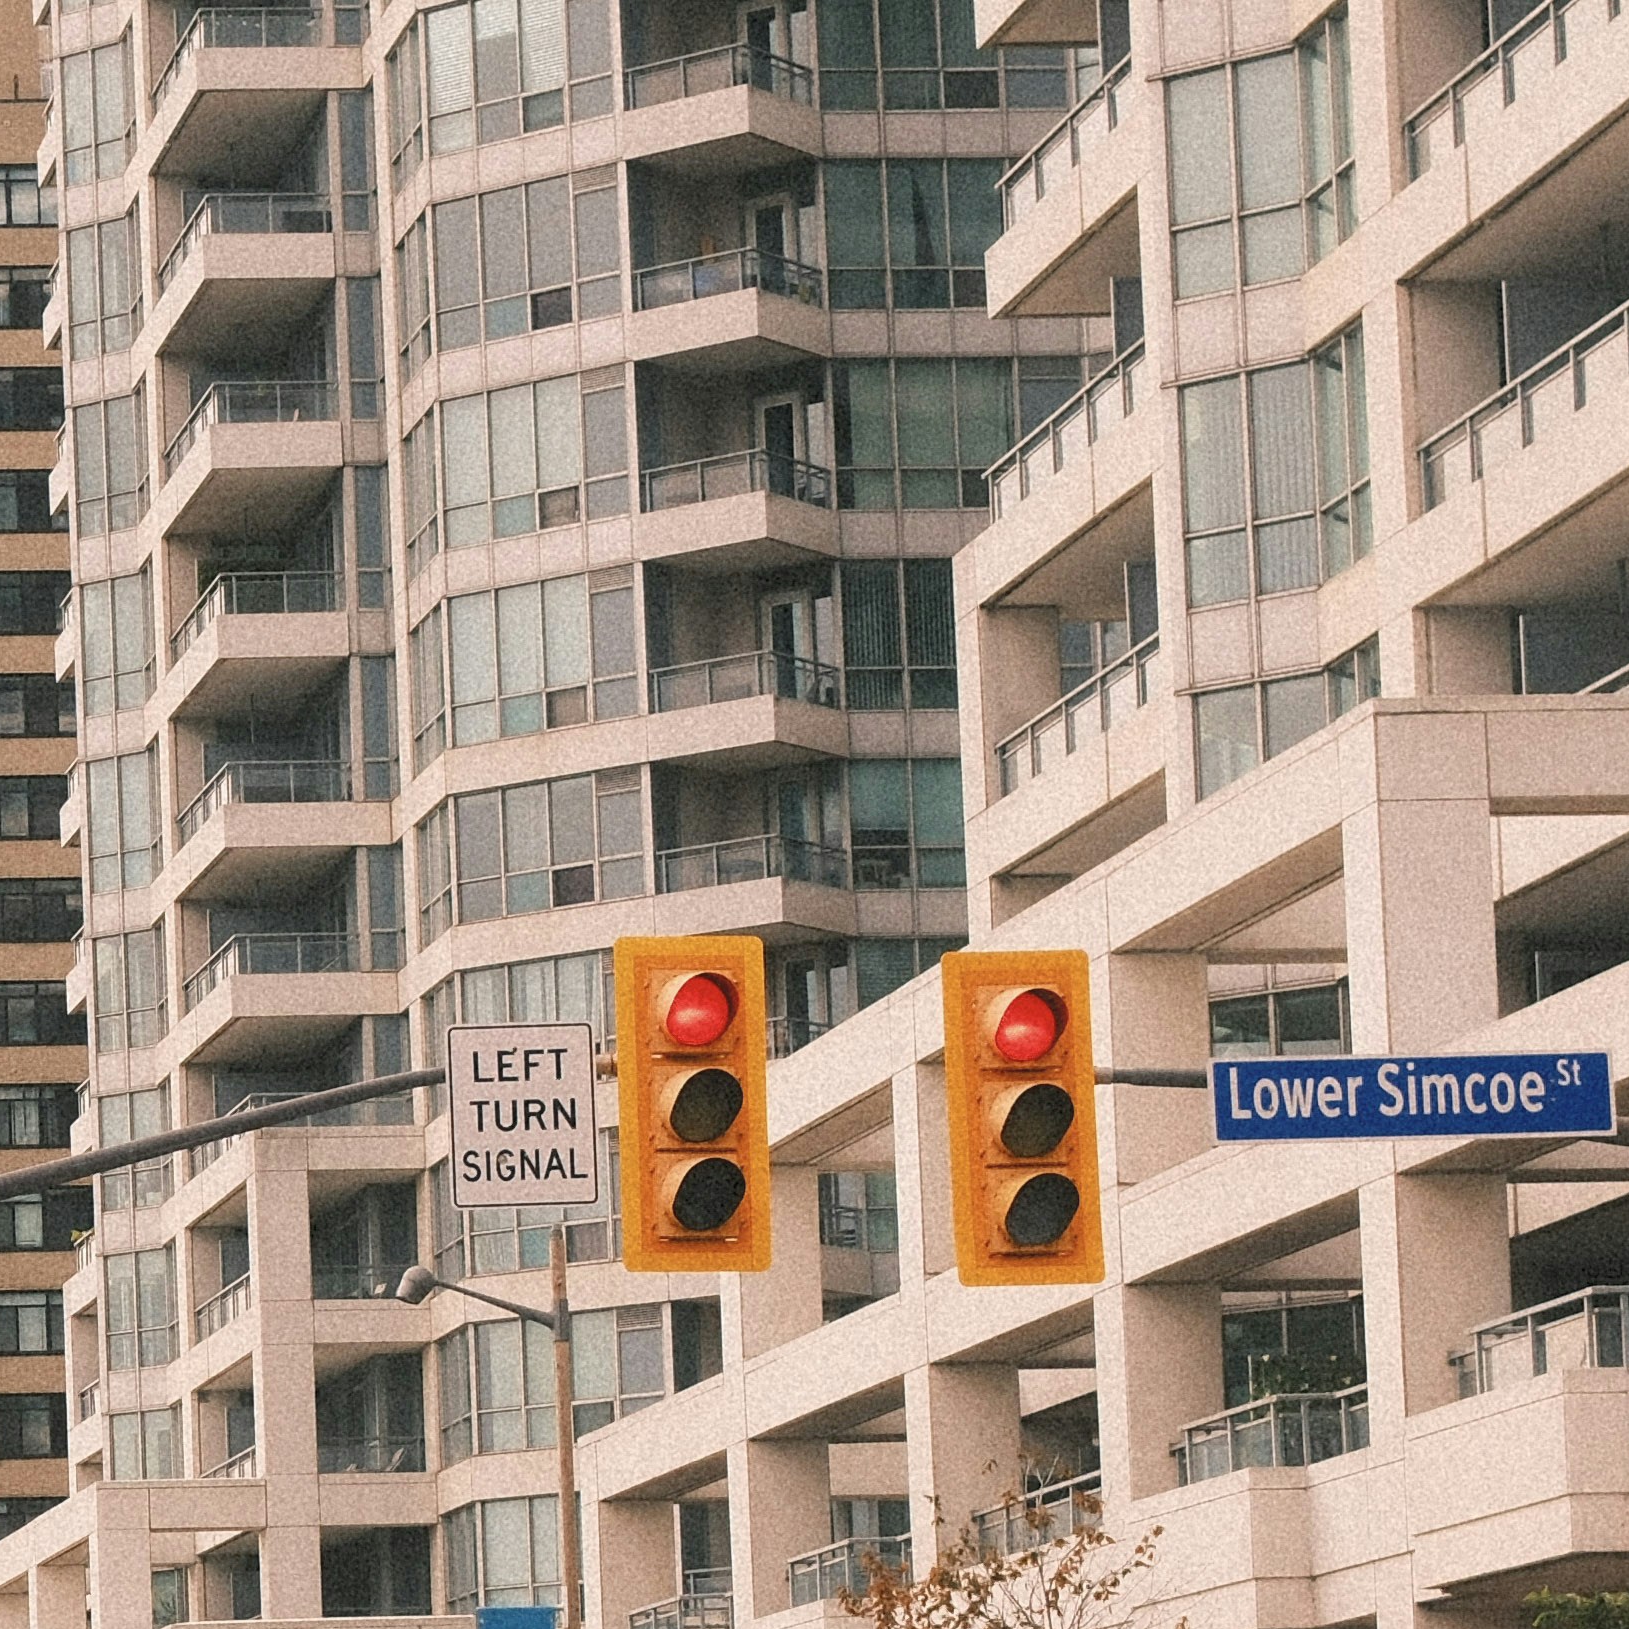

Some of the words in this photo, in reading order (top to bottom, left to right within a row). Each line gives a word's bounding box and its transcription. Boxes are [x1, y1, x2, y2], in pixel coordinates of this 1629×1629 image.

[473, 1048, 568, 1082] LEFT
[1229, 1067, 1363, 1120] Lower
[1377, 1063, 1545, 1116] Simcoe
[1557, 1059, 1582, 1086] St
[469, 1098, 576, 1132] TURN
[463, 1148, 588, 1182] SIGNAL
